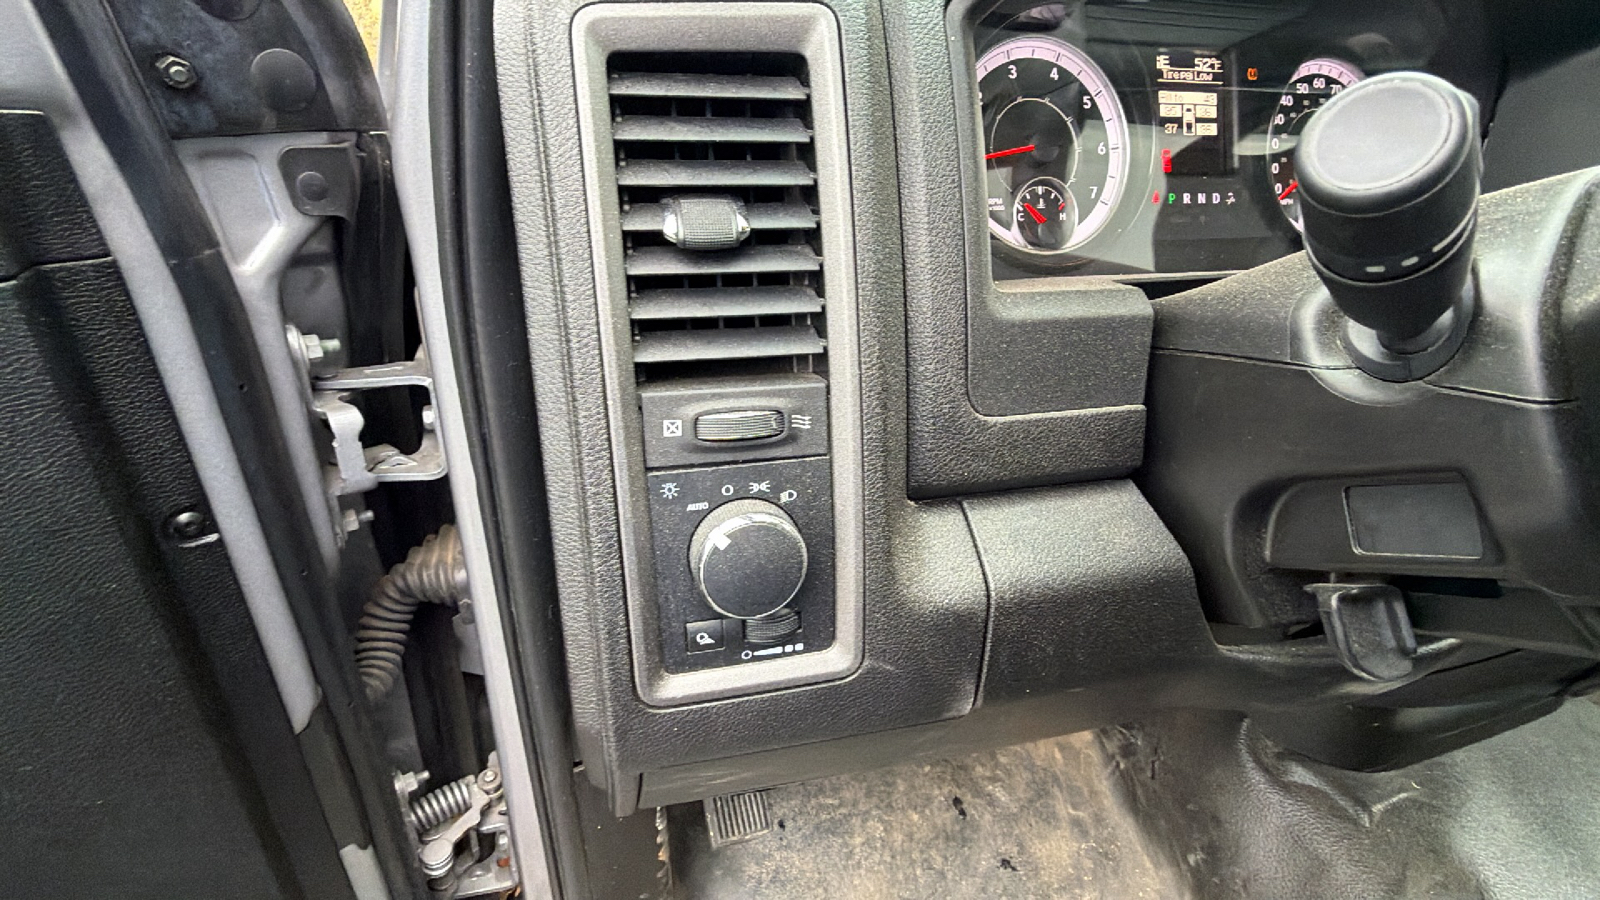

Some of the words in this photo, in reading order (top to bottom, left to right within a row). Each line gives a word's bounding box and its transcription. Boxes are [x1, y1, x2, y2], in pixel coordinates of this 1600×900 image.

[1008, 65, 1017, 79] 3
[1050, 67, 1059, 80] 4
[1296, 83, 1309, 94] 50
[1313, 78, 1325, 88] 60
[1329, 84, 1343, 95] 70
[1083, 96, 1092, 109] 5
[1280, 95, 1294, 107] 40
[1164, 123, 1178, 134] 37
[1097, 142, 1106, 155] 6
[1089, 186, 1099, 199] 7
[1168, 193, 1176, 204] P
[1183, 193, 1191, 204] R
[1197, 193, 1206, 204] N
[1212, 193, 1220, 204] D
[1018, 213, 1025, 221] C
[1060, 213, 1066, 221] H
[686, 502, 709, 512] AUTO
